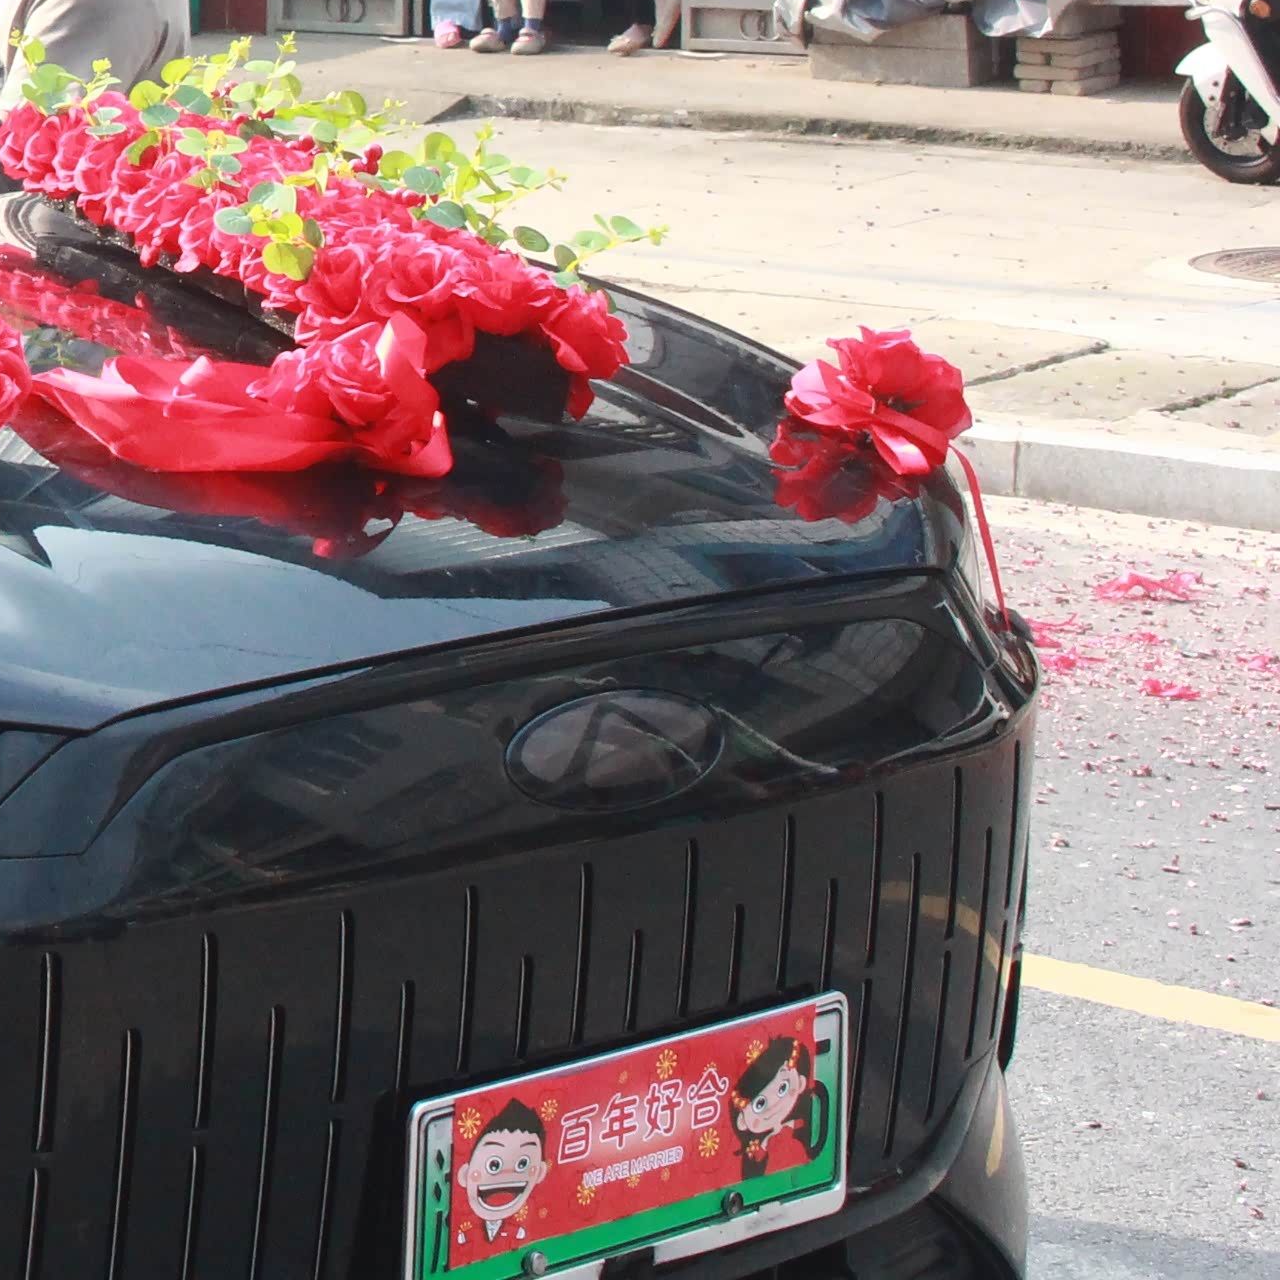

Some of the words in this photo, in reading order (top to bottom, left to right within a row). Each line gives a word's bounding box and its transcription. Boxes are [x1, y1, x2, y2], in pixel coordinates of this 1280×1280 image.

[557, 1067, 729, 1164] 百年好合
[583, 1168, 604, 1189] WE
[604, 1161, 629, 1184] ARE
[630, 1146, 683, 1176] MARRIED
